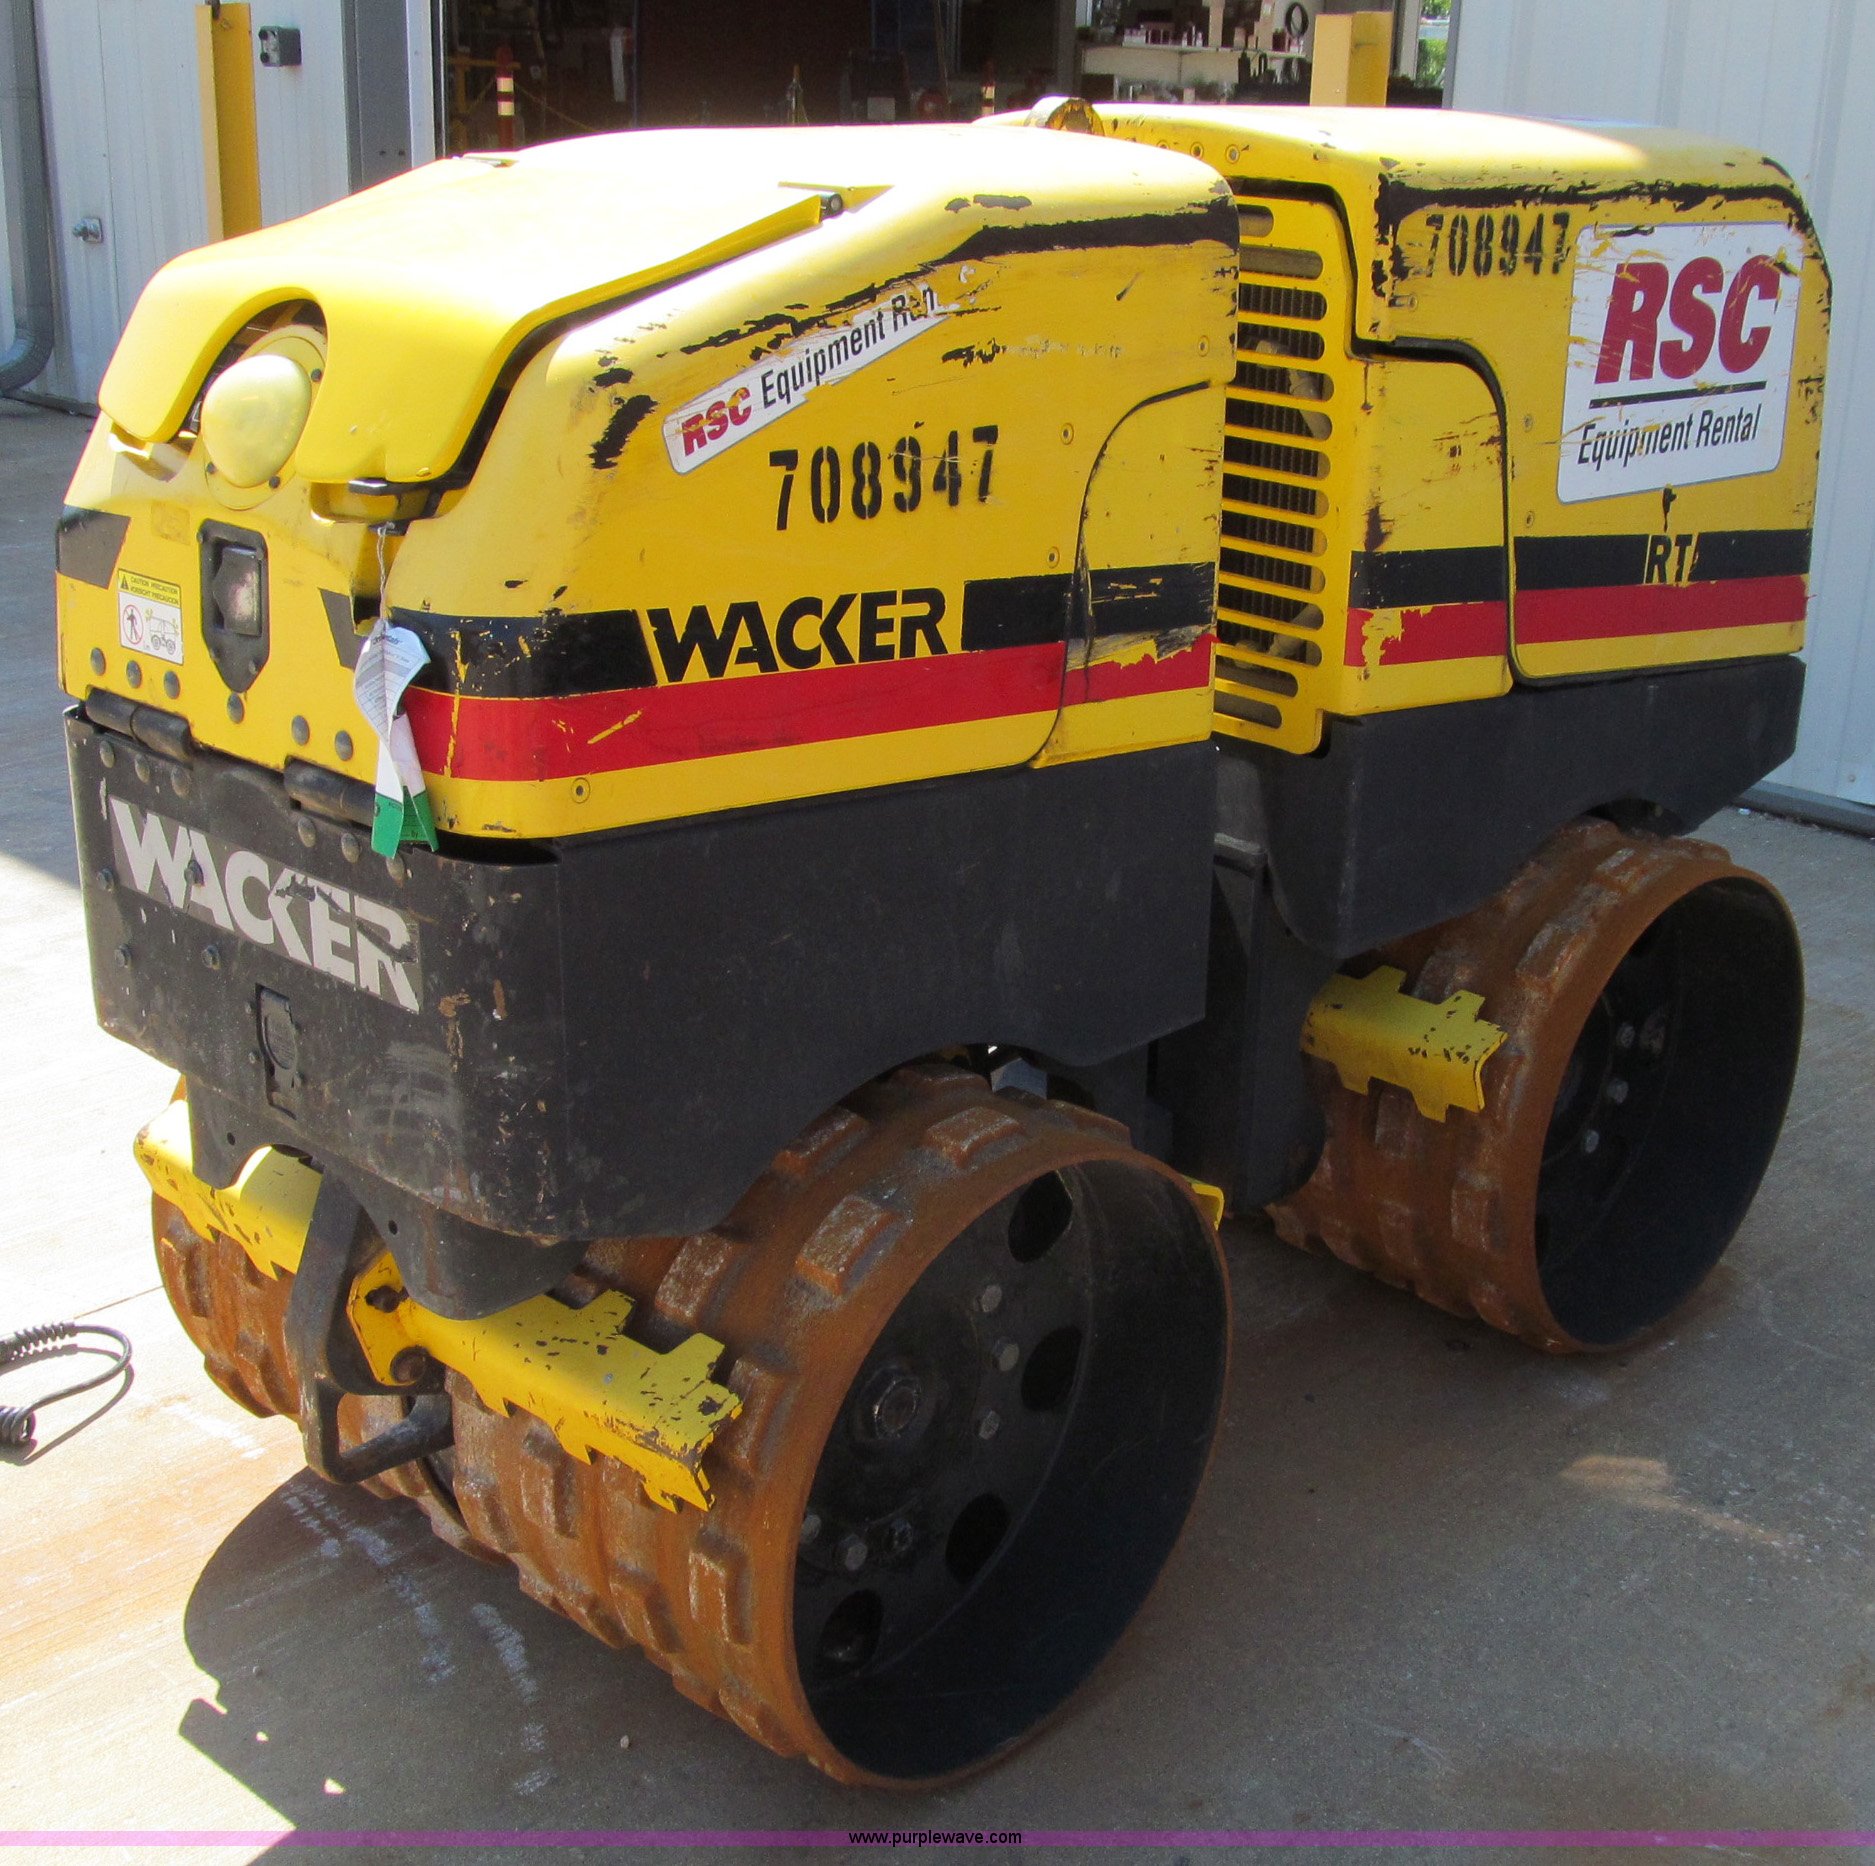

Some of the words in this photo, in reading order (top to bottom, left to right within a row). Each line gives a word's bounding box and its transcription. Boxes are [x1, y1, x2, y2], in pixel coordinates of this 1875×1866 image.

[1426, 212, 1571, 277] 708947
[1594, 255, 1781, 384] RSC
[681, 387, 752, 457] RSC
[761, 310, 886, 410] Equipment
[769, 424, 999, 531] 708947
[1577, 415, 1694, 471] Equipment
[1699, 404, 1762, 447] Rental
[647, 588, 949, 683] WACKER
[109, 796, 420, 1015] WACKER
